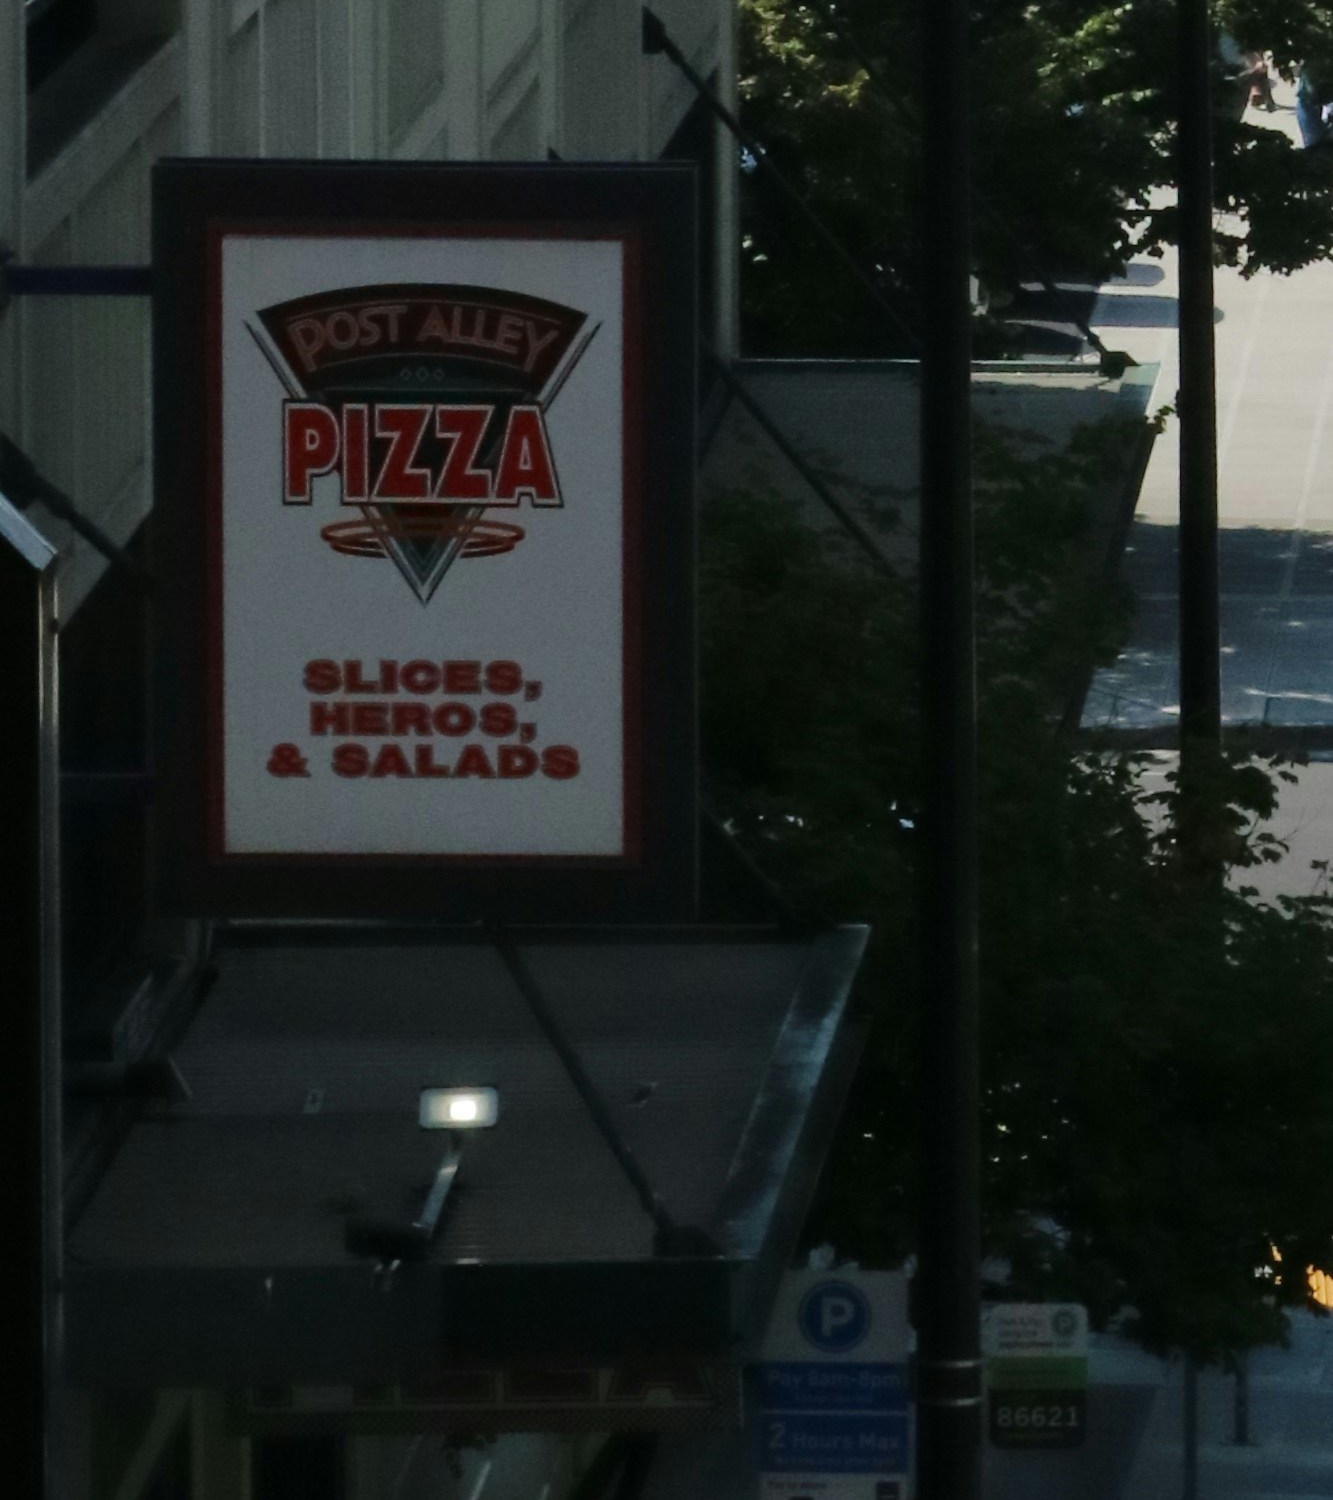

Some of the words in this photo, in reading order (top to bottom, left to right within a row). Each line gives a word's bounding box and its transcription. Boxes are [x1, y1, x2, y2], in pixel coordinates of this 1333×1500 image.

[286, 303, 409, 371] POST
[417, 305, 562, 371] ALLEY
[281, 401, 564, 507] PIZZA
[302, 658, 543, 702] SLICES,
[310, 701, 538, 743] HEROS,
[266, 744, 312, 779] &
[330, 743, 581, 779] SALADS
[819, 1295, 855, 1338] P
[767, 1369, 802, 1390] Pay
[807, 1369, 901, 1389] 8am-8pm
[768, 1422, 786, 1450] 2
[792, 1431, 854, 1450] Hours
[858, 1431, 900, 1450] Max
[996, 1404, 1080, 1428] 86621
